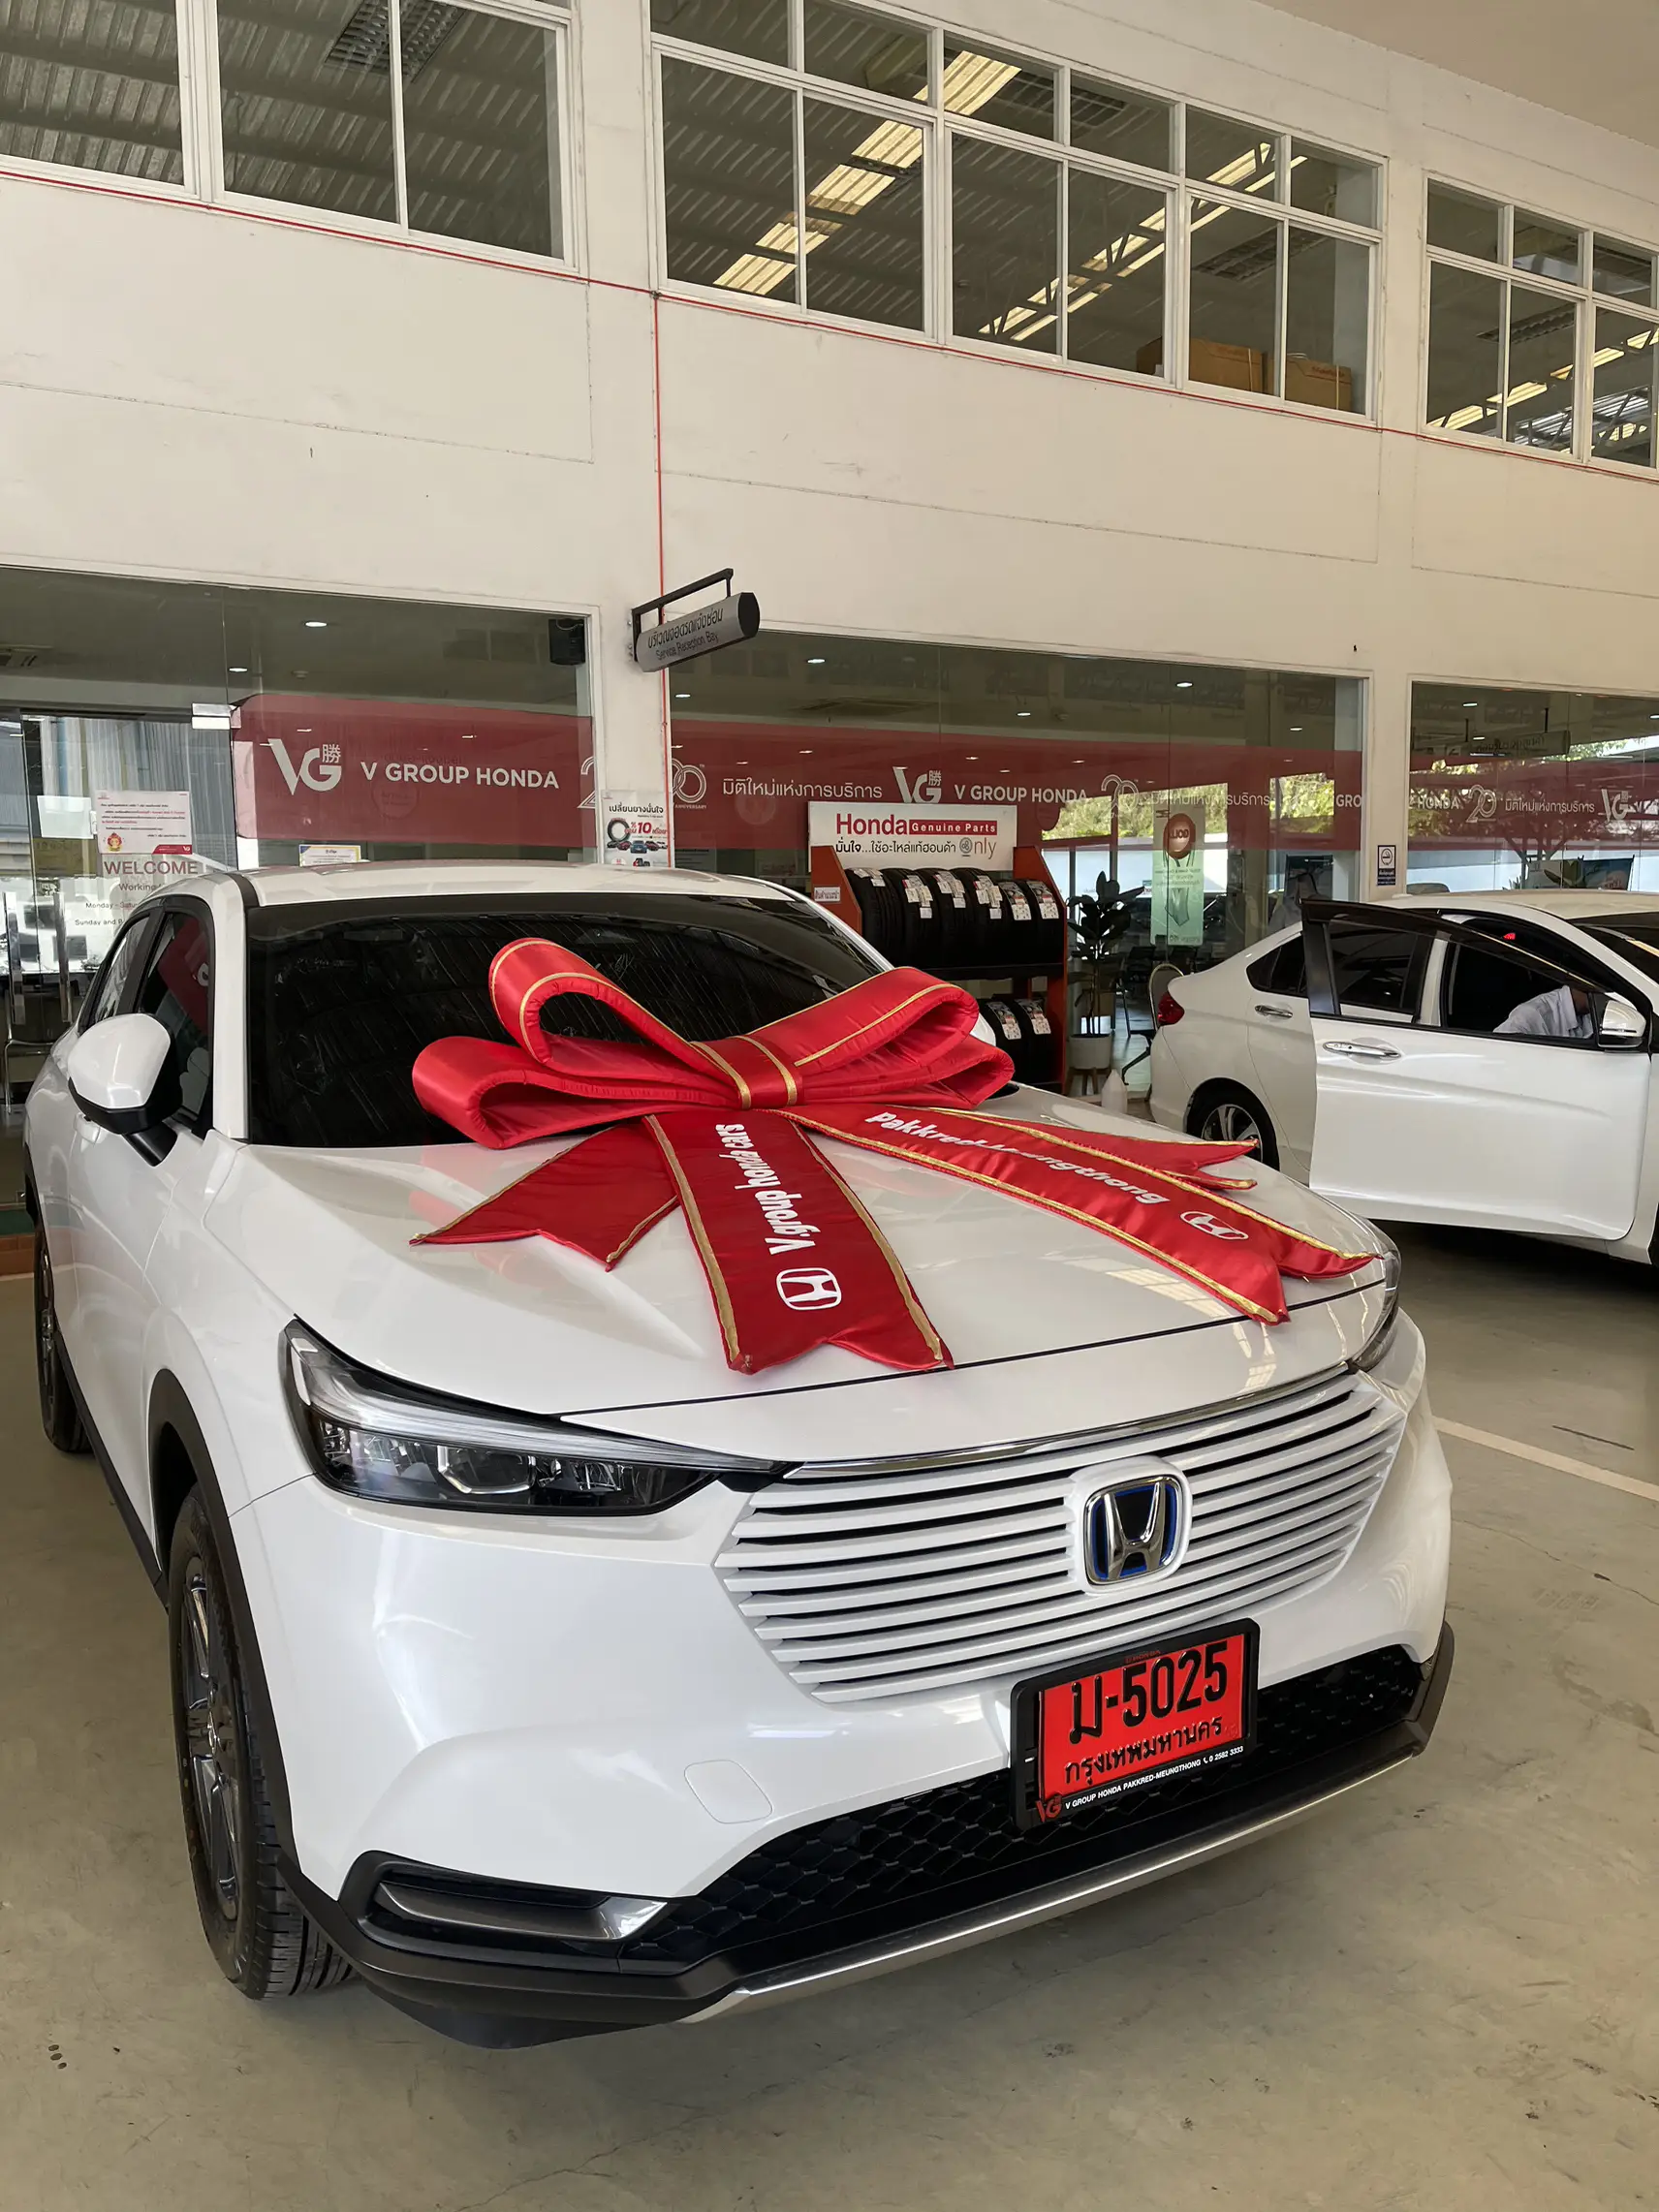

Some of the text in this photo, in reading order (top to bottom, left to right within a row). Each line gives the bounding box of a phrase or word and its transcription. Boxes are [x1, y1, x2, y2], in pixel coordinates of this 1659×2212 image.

[656, 631, 719, 661] Service Reception Bay
[360, 762, 559, 790] V GROUP HONDA
[723, 777, 883, 798] มิติใหม่แห่งการบริการ
[954, 784, 1087, 803] V GROUP HONDA
[638, 822, 652, 834] 10
[836, 813, 996, 835] Honda Genuine Parts
[104, 860, 199, 875] WELCOME
[119, 883, 156, 891] Working
[715, 1124, 754, 1149] cars
[719, 1150, 781, 1190] honda
[1064, 1716, 1223, 1785] กรุงเทพมหานคร
[1065, 1801, 1071, 1810] V
[1072, 1793, 1096, 1808] GROUP
[1098, 1785, 1121, 1799] HONDA
[1123, 1759, 1202, 1790] PAKKRED-MEUNGTHONG
